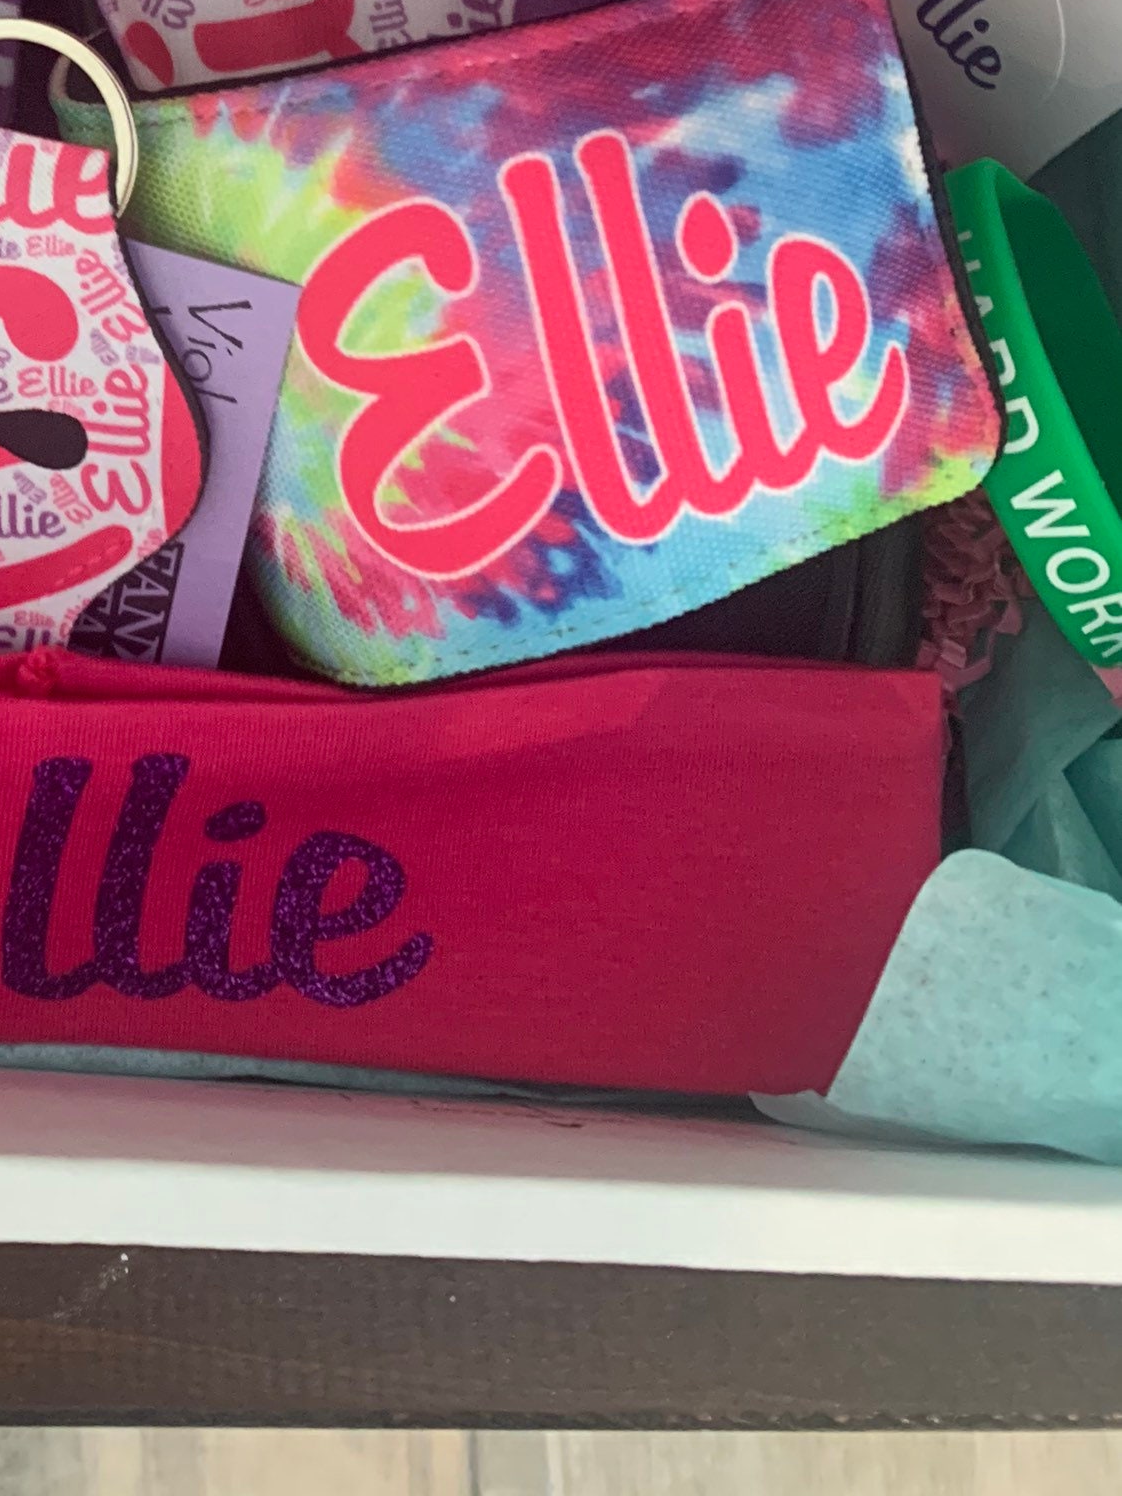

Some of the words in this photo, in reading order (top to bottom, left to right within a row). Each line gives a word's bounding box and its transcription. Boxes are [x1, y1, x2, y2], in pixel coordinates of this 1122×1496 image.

[75, 248, 149, 343] Ellie
[297, 130, 908, 580] Ellie
[16, 365, 99, 398] Ellie
[80, 363, 152, 515] Ellie
